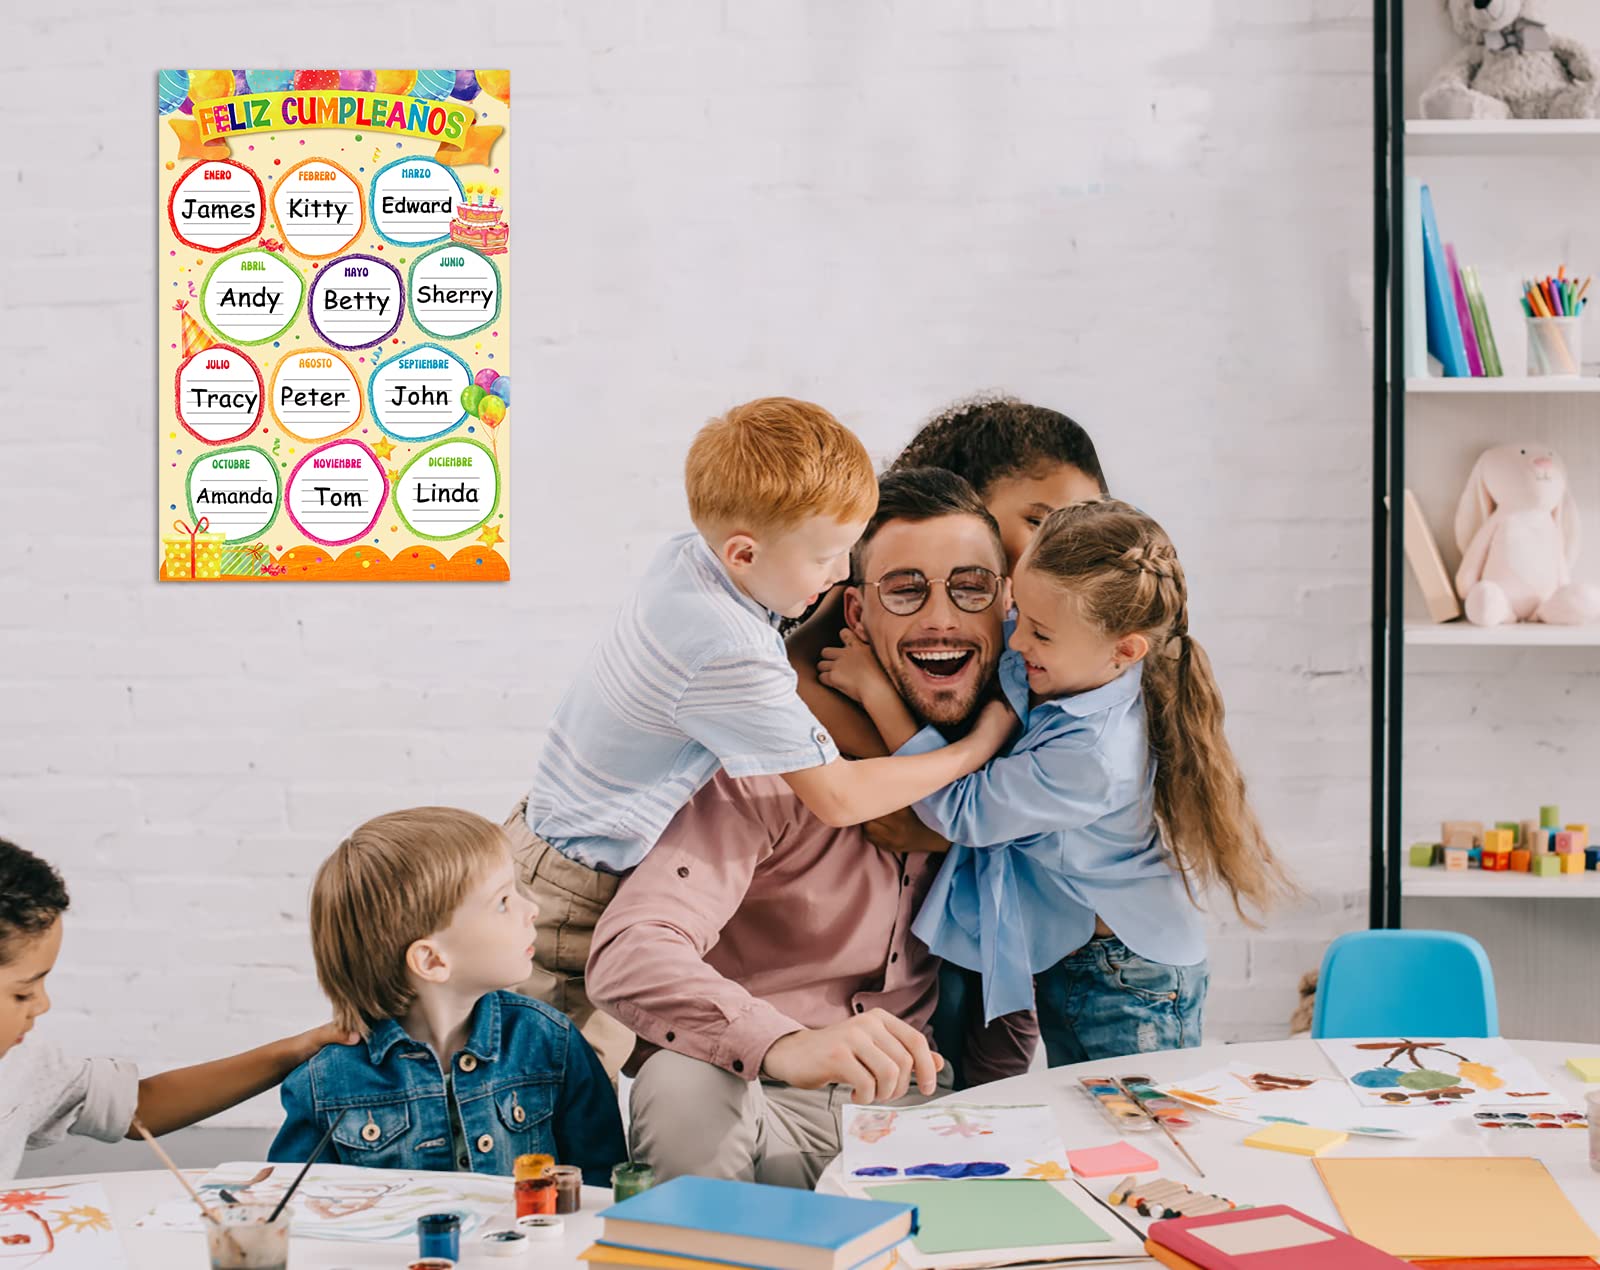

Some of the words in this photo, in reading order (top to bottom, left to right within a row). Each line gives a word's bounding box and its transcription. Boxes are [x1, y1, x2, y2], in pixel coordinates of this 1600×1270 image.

[199, 98, 271, 136] FELIZ
[282, 96, 466, 139] CUMPLEAÑOS
[204, 170, 232, 180] ENERO
[299, 171, 336, 181] FEBRERO
[402, 168, 431, 179] MARZO
[181, 199, 255, 219] James
[289, 198, 347, 224] Kitty
[382, 196, 452, 214] Edward
[241, 261, 266, 271] ABRIL
[440, 257, 465, 267] JUNIO
[345, 267, 369, 278] MAYO
[220, 287, 280, 313] Andy
[325, 290, 390, 316] Betty
[417, 285, 493, 309] Sherry
[206, 359, 230, 370] JULIO
[299, 358, 332, 369] AGOSTO
[399, 359, 449, 369] SEPTIEMBRE
[191, 388, 258, 414] Tracy
[282, 386, 345, 407] Peter
[391, 385, 448, 406] John
[212, 459, 250, 469] OCTUBRE
[314, 458, 362, 469] NOVIEMBRE
[429, 457, 472, 467] DICIEMBRE
[196, 487, 273, 504] Amanda
[314, 487, 362, 507] Tom
[416, 483, 478, 503] Linda
